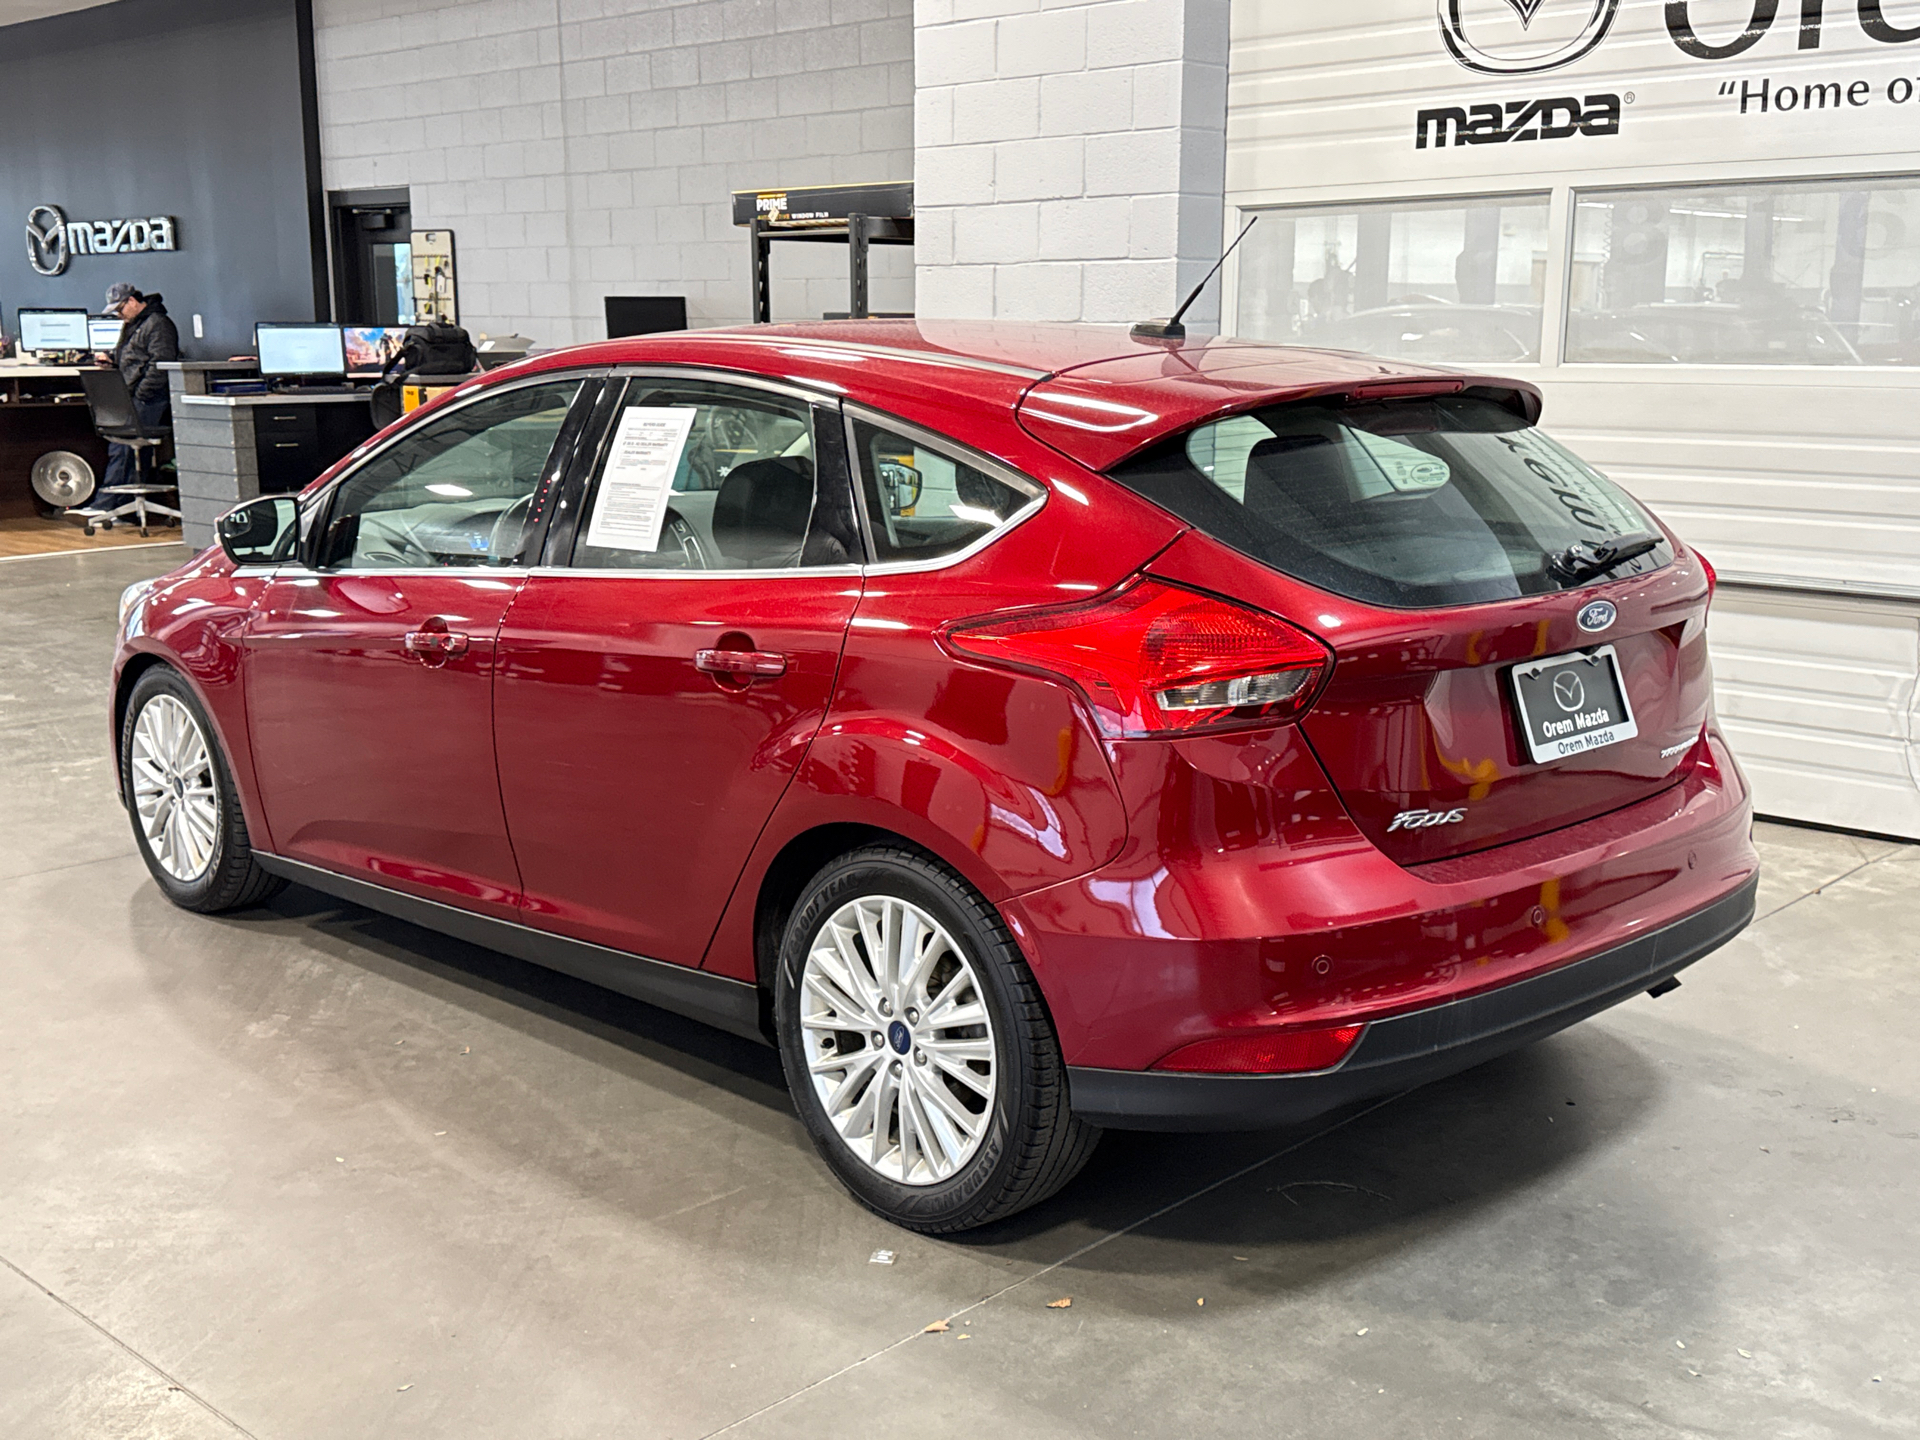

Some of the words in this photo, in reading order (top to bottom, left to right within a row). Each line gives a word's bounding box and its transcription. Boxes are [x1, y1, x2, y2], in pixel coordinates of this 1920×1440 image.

[1887, 77, 1920, 104] o
[1415, 93, 1620, 149] mazda
[756, 197, 788, 212] PRIME
[66, 216, 174, 255] mazda
[1587, 607, 1608, 625] Ford
[1543, 719, 1574, 737] Orem
[1574, 707, 1609, 730] Mazda
[1558, 740, 1583, 755] Orem
[1584, 730, 1614, 748] Mazda
